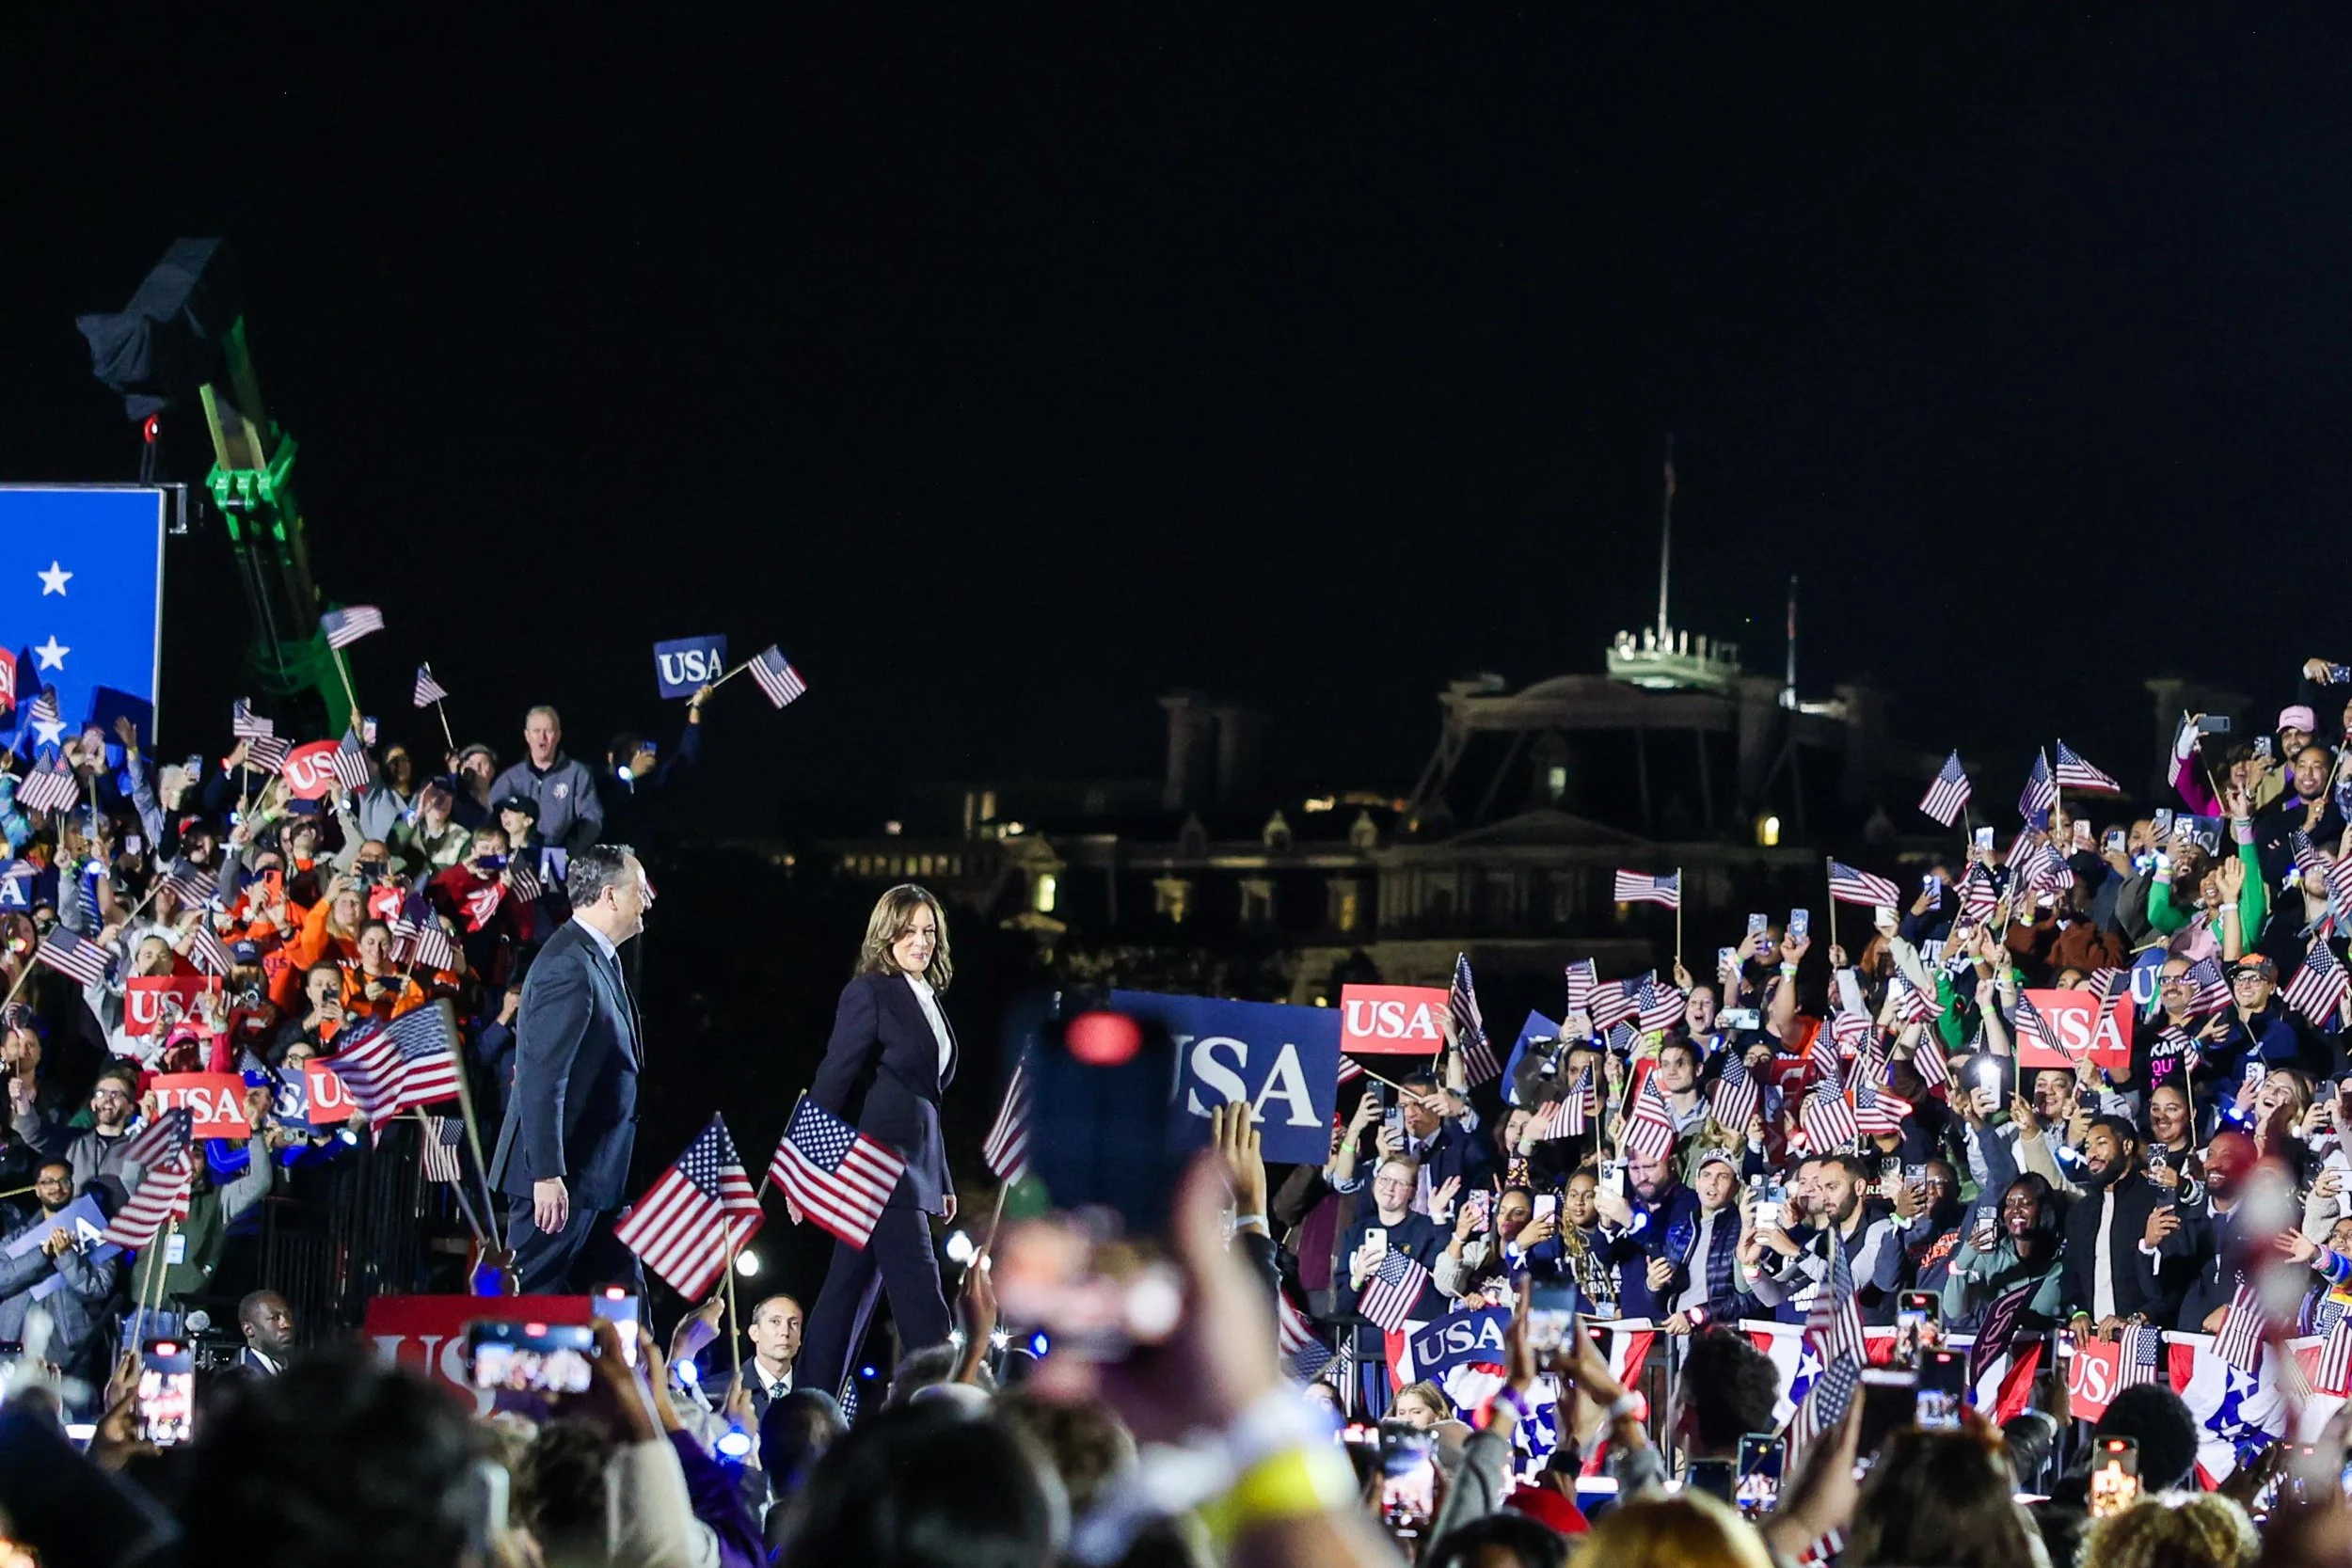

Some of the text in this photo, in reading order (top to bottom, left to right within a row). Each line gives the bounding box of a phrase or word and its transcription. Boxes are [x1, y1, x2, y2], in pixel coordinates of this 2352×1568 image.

[659, 647, 723, 685] USA
[286, 750, 336, 790] US
[129, 990, 213, 1024] USA
[1346, 1000, 1439, 1039] USA
[2028, 1006, 2127, 1051] USA
[2150, 1040, 2185, 1057] KAM
[2151, 1058, 2176, 1077] QU
[155, 1086, 246, 1124] USA
[1414, 1316, 1506, 1366] USA
[1976, 1285, 2031, 1377] USA
